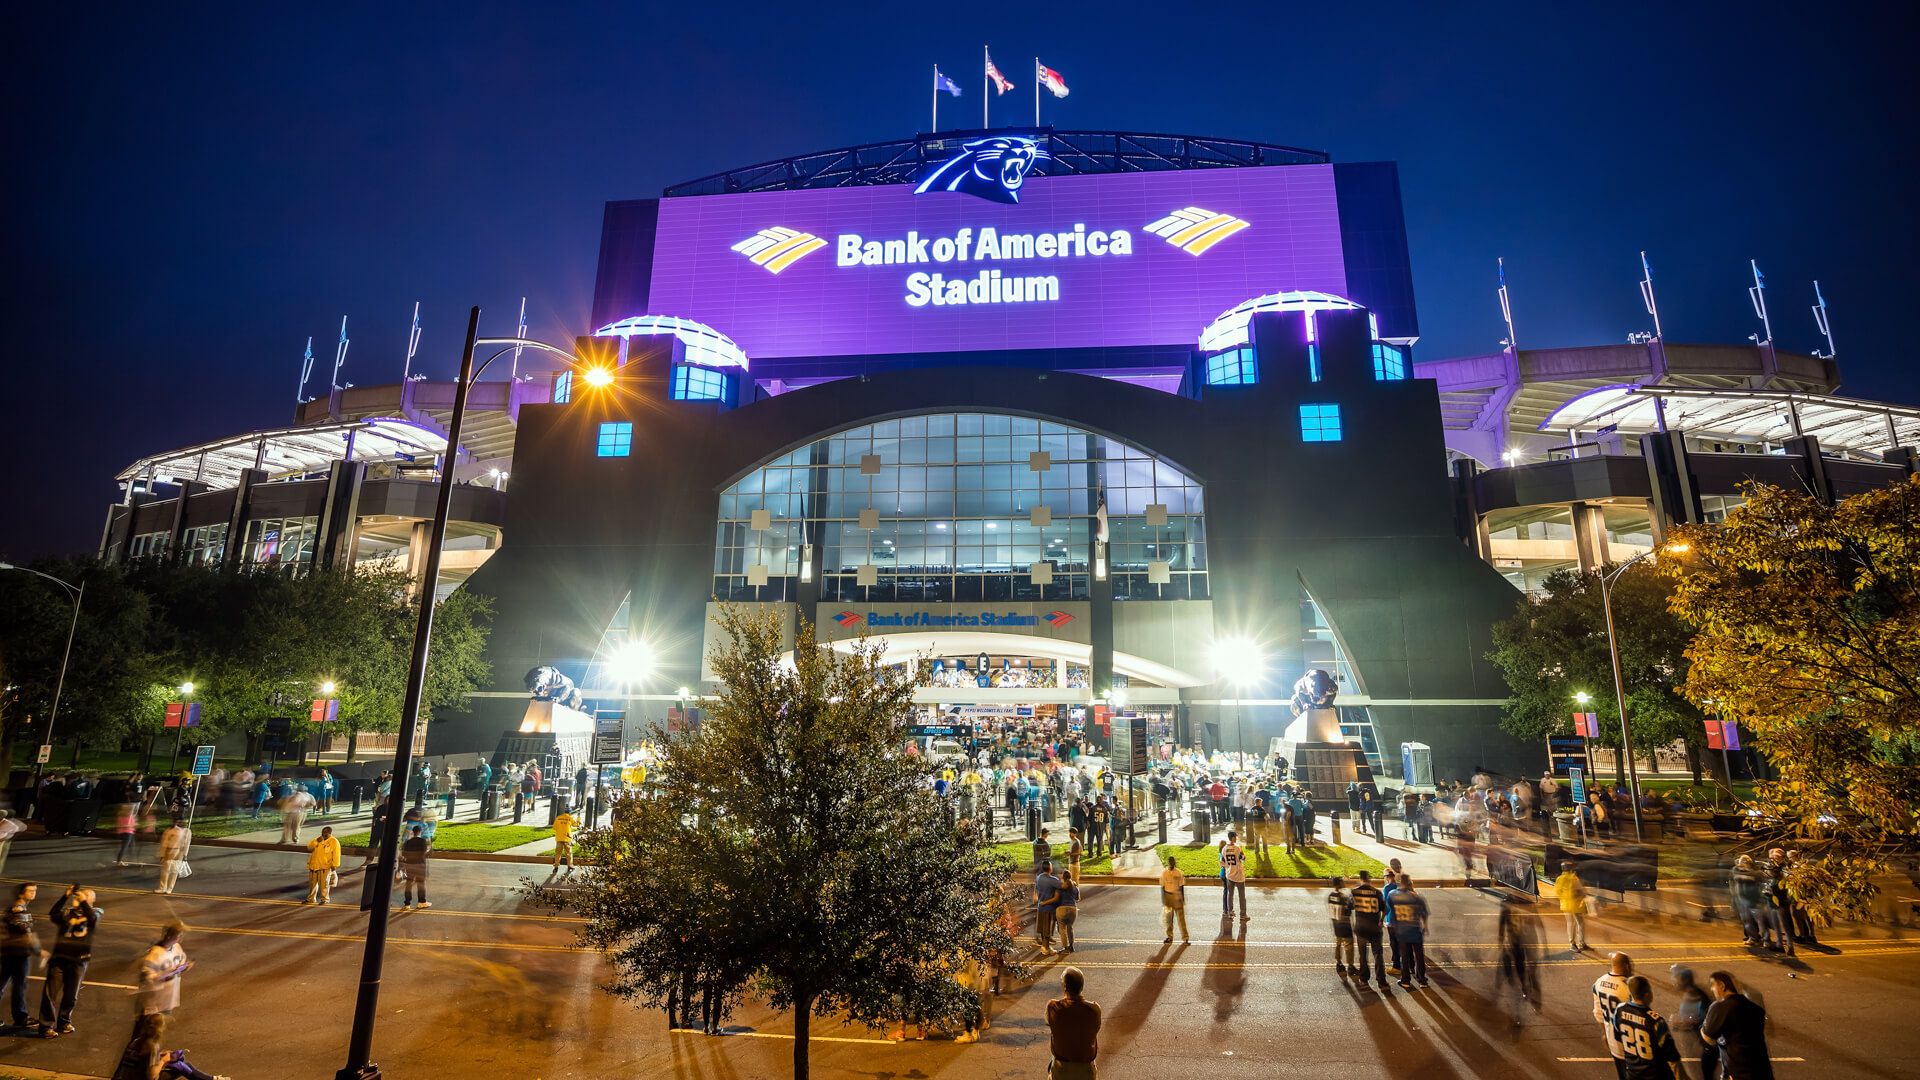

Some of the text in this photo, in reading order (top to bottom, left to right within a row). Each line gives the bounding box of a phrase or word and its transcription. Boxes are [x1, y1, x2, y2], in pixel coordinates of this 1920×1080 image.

[837, 223, 1133, 267] Bank of America
[904, 269, 1059, 307] Stadium
[867, 611, 1040, 626] Bank of America Stadium
[979, 656, 987, 671] E
[1621, 1011, 1646, 1025] STEWART
[1620, 1023, 1653, 1060] 28
